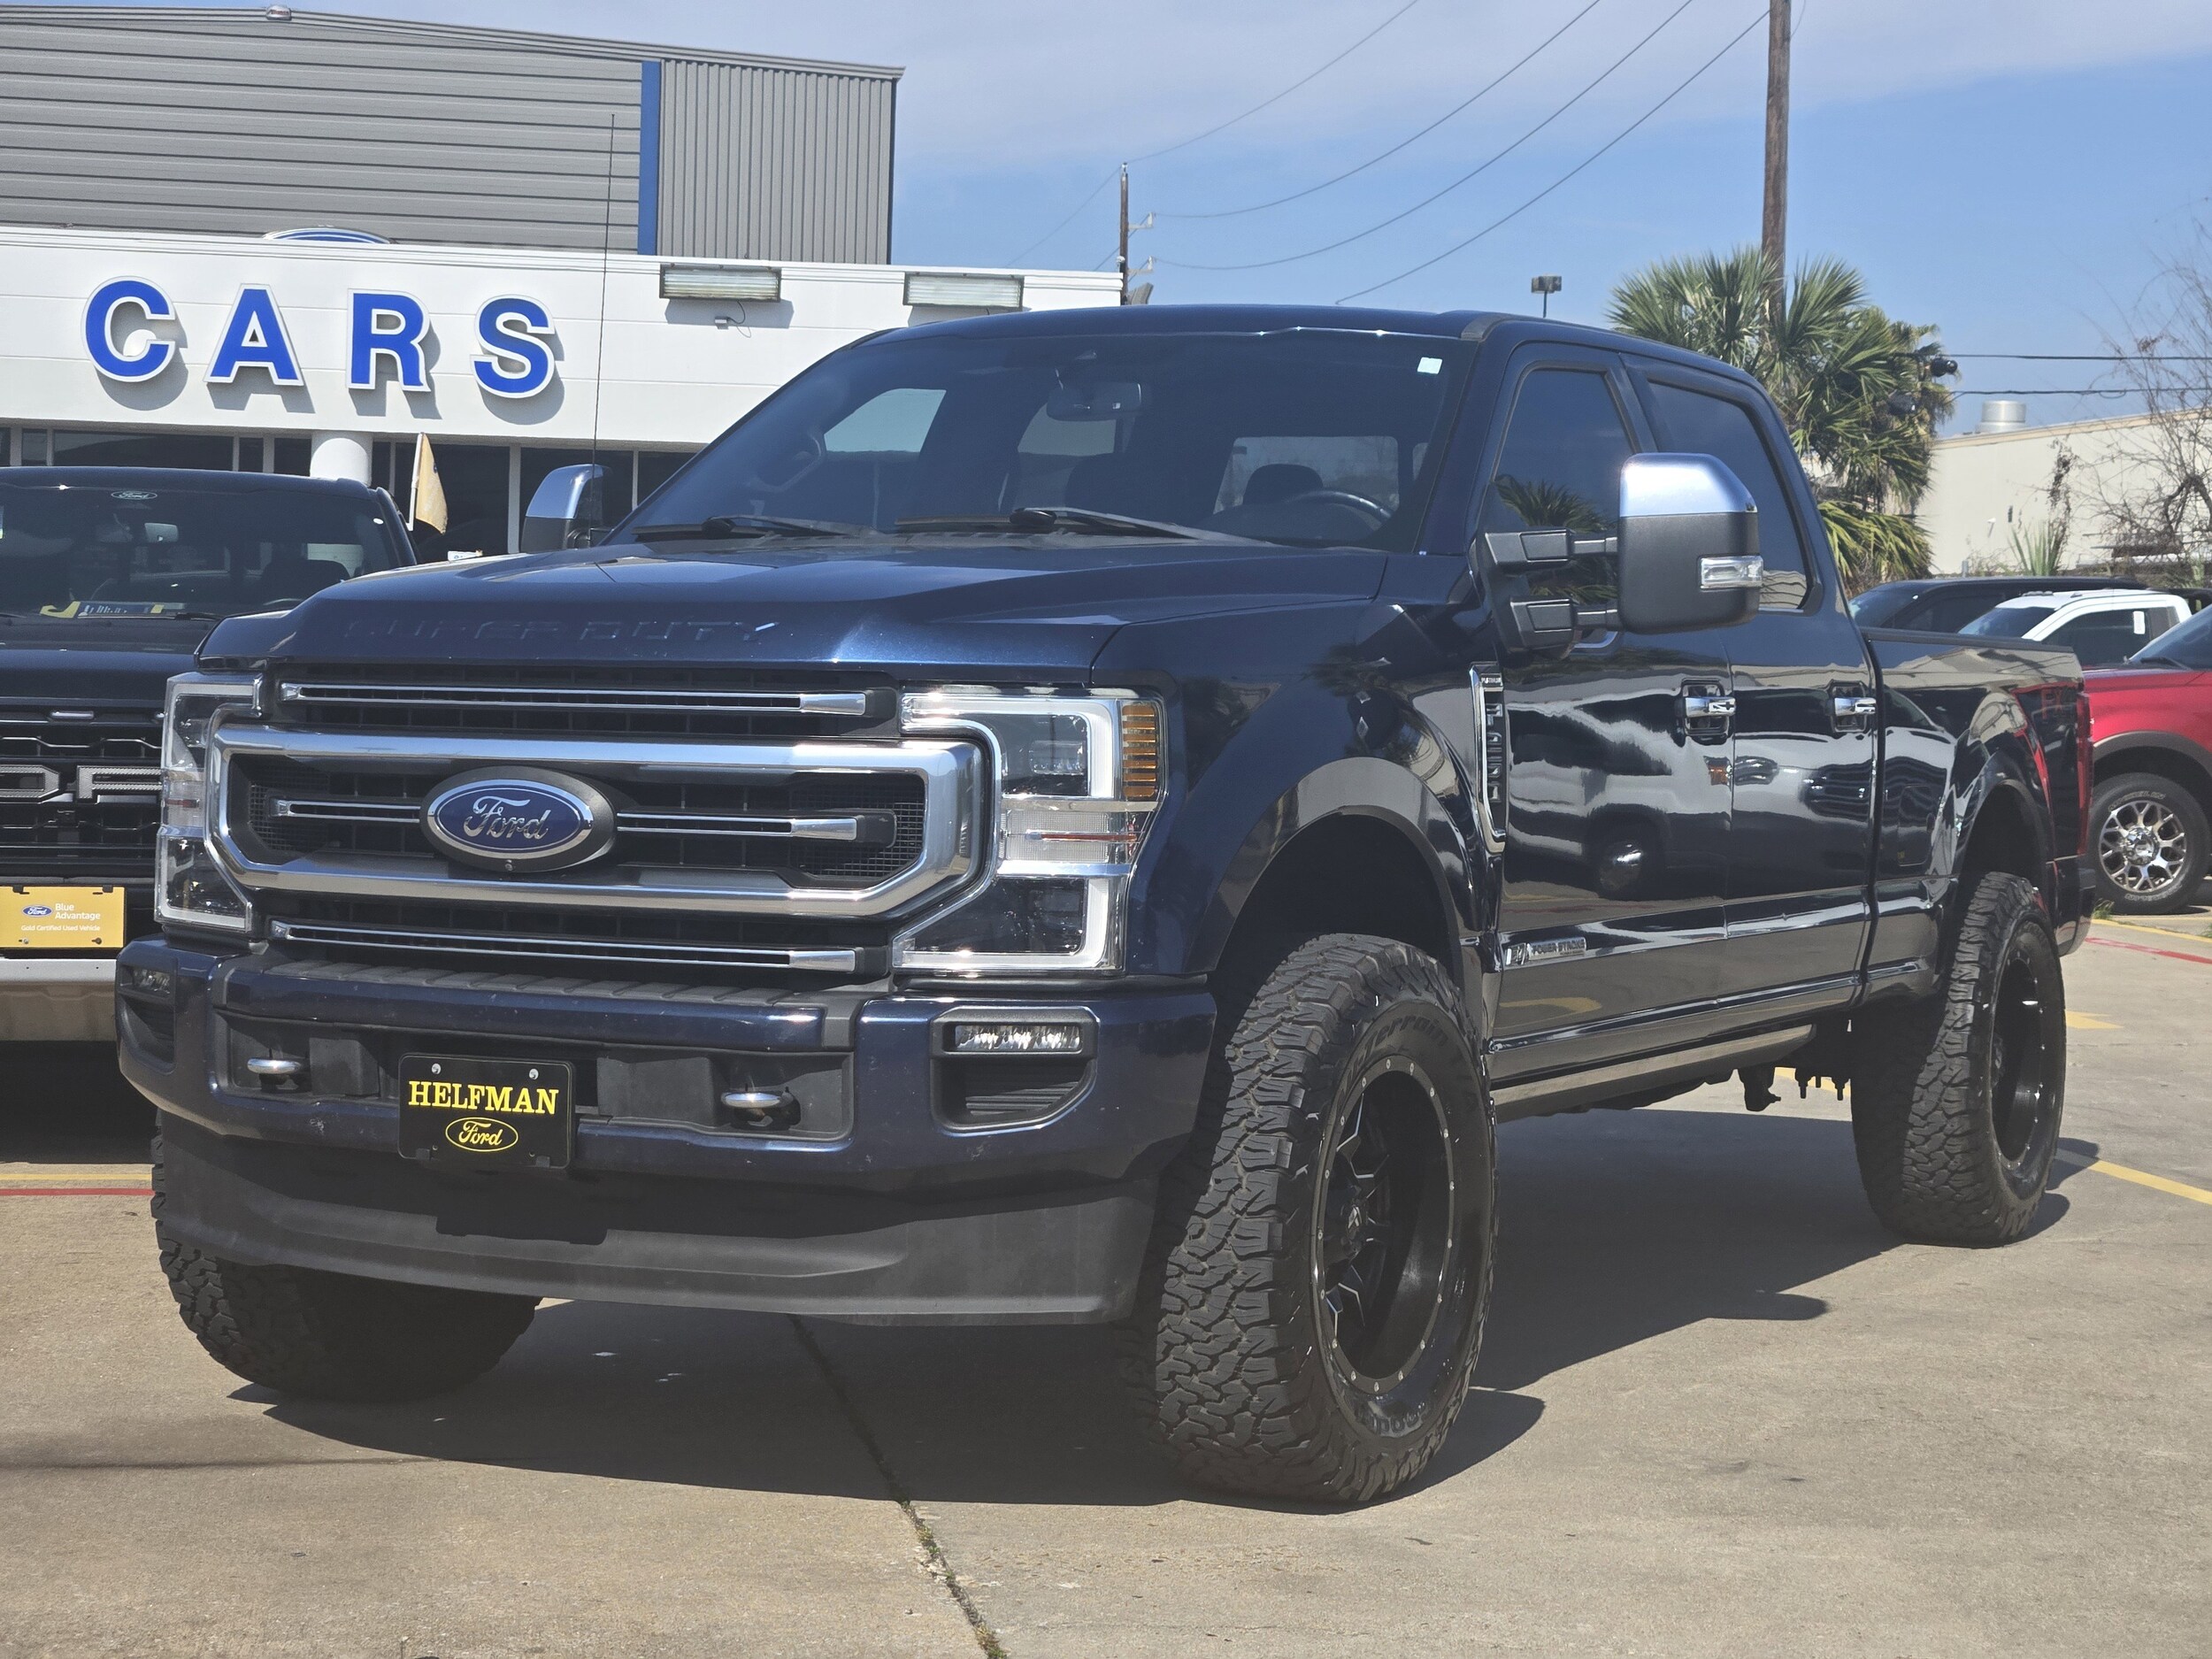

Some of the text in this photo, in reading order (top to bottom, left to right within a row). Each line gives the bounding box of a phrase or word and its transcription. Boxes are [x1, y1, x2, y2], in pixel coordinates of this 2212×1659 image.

[81, 275, 555, 399] CARS
[463, 795, 551, 840] Ford
[55, 912, 101, 921] Advantage
[408, 1080, 559, 1115] HELFMAN
[458, 1120, 503, 1146] Ford
